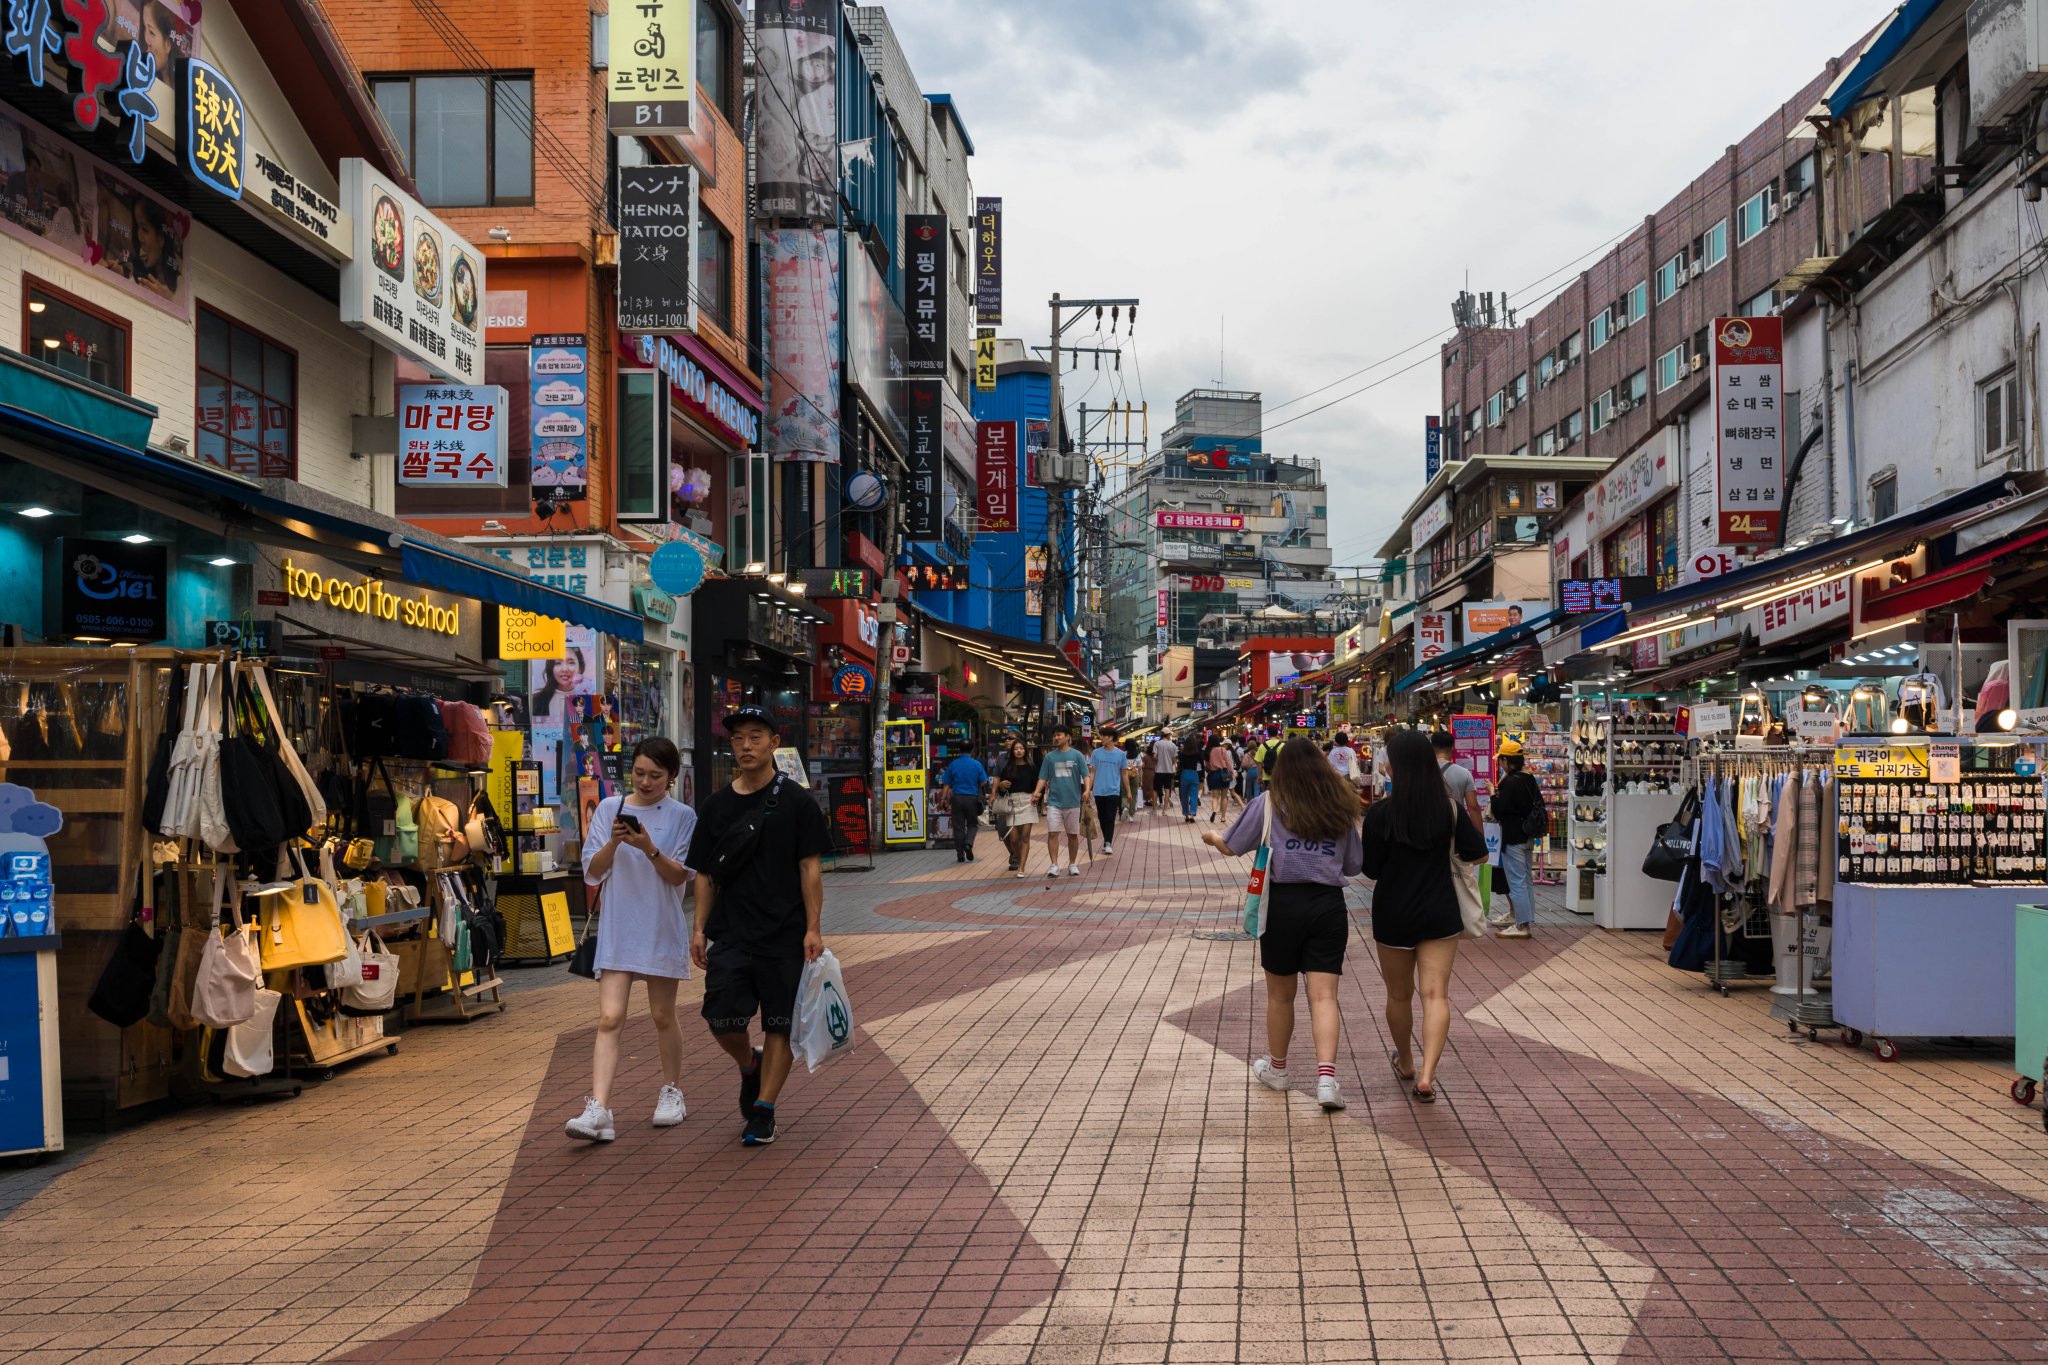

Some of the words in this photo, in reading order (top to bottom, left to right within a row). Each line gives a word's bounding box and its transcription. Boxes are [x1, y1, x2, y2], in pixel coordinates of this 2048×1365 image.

[614, 67, 684, 92] 프렌즈
[635, 105, 662, 124] B1
[255, 153, 294, 195] 가맹문의
[626, 176, 684, 195] ヘンナ
[623, 204, 685, 217] HENNA
[623, 225, 687, 238] TATTOO
[633, 245, 669, 262] 文身
[981, 215, 997, 275] 더하우스
[916, 252, 937, 343] 핑거뮤직
[978, 295, 1000, 303] Single
[978, 302, 999, 310] Room
[619, 313, 687, 327] 02)6451-1001
[542, 336, 583, 345] 포토프렌즈
[455, 347, 472, 376] 米线
[978, 341, 995, 383] 사진
[424, 389, 475, 401] 麻辣烫
[660, 337, 706, 404] PHOTO
[711, 381, 758, 445] FRIENDS
[1726, 397, 1774, 410] 순대국
[405, 404, 495, 431] 마라탕
[1725, 426, 1777, 440] 뼈해장국
[433, 439, 466, 451] 米线
[402, 452, 495, 479] 쌀국수
[1212, 449, 1229, 469] G
[914, 416, 933, 533] 도쿄스테이크
[985, 426, 1008, 515] 보드게임
[1728, 487, 1776, 501] 삼겹살
[984, 519, 1010, 528] Cafe
[1729, 515, 1751, 534] 24
[527, 546, 587, 568] 전문점
[1191, 575, 1225, 592] DVD
[286, 558, 323, 601] too
[328, 578, 370, 614] cool
[374, 581, 401, 621] for
[405, 594, 459, 635] school
[506, 615, 537, 627] cool
[506, 628, 526, 640] for
[506, 640, 554, 652] school
[1854, 750, 1892, 763] 귀걸이
[1836, 764, 1862, 777] 모든
[887, 775, 921, 784] 방송출연
